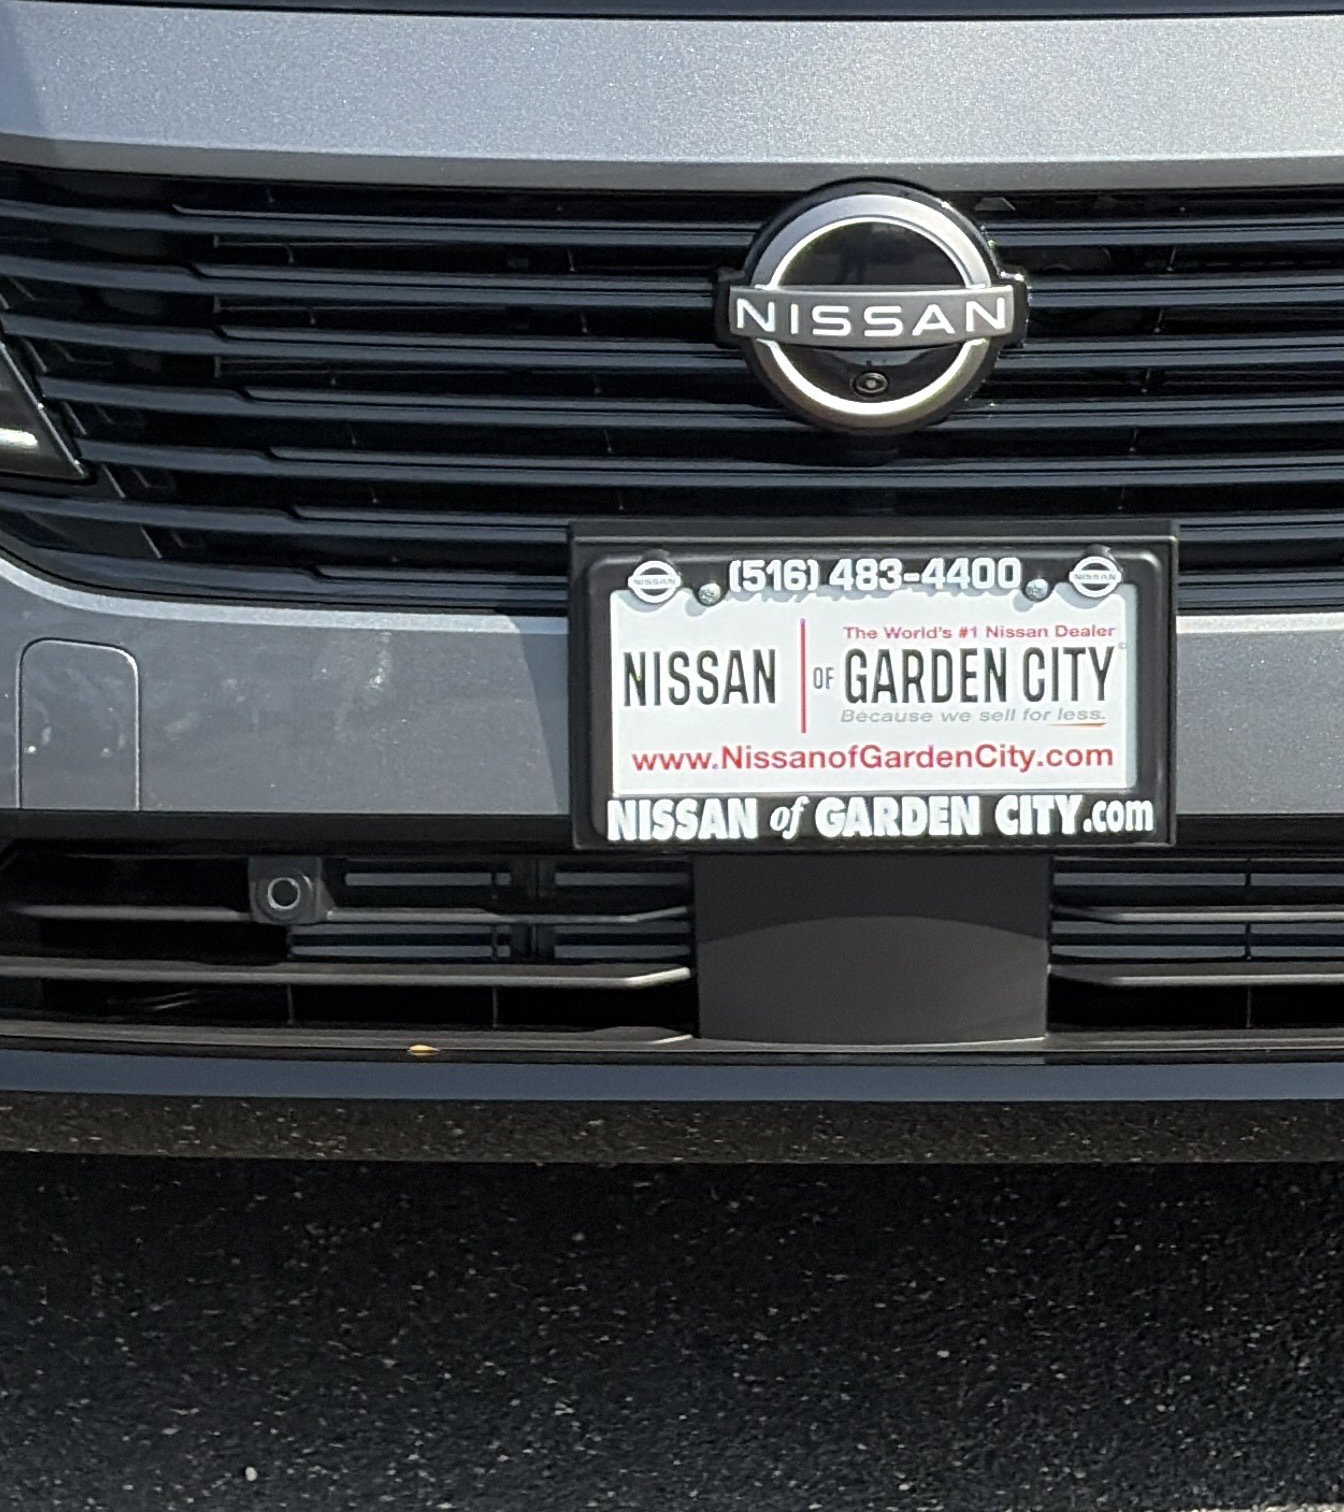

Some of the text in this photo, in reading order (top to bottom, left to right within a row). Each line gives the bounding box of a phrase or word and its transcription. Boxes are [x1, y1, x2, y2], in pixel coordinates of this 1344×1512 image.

[736, 297, 1006, 337] NISSAN
[729, 557, 1022, 592] (516) 483-4400
[843, 624, 1115, 639] The World's #1 Nissan Dealer
[623, 646, 1115, 706] NISSAN OF GARDEN CITY
[840, 707, 1106, 723] Because we sell for less.
[632, 744, 1113, 773] www.NissanofGardenCity.com
[607, 794, 1154, 841] NISSAN of GARDEN CITY.com
